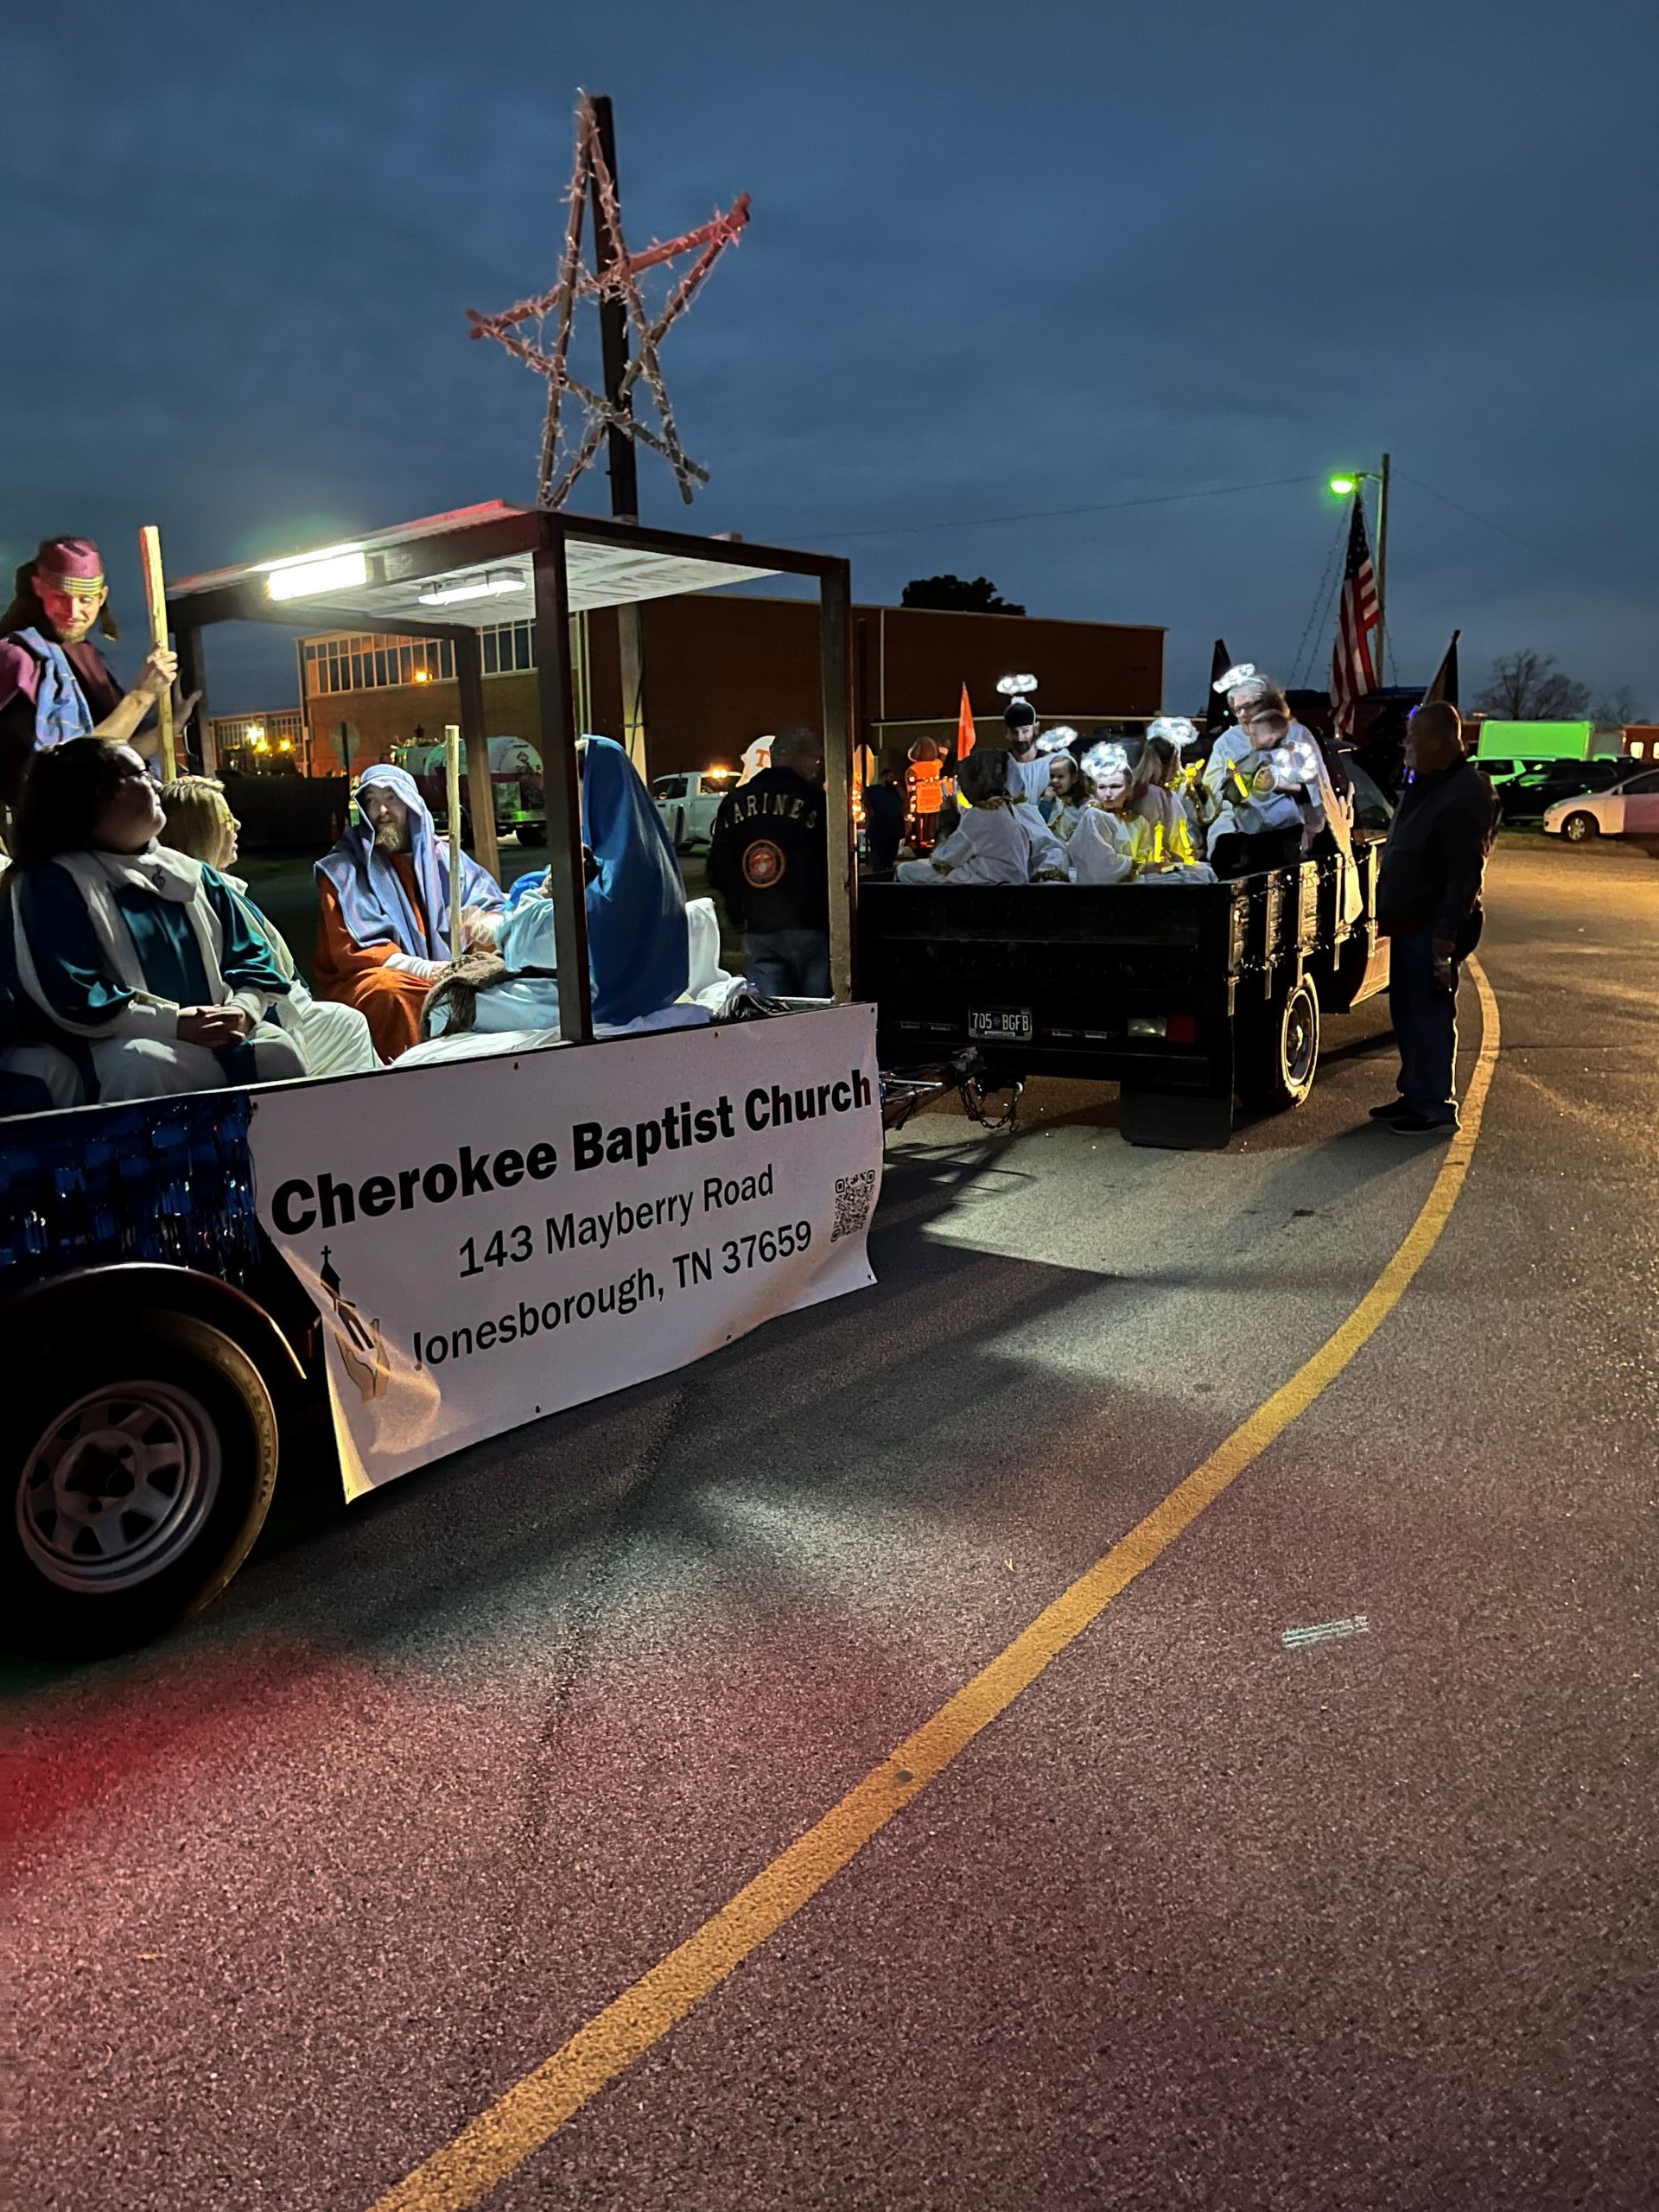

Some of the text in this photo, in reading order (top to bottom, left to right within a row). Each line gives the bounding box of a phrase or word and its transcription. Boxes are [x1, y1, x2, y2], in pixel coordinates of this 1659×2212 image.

[972, 1013, 1029, 1031] 705 BGFB
[271, 1069, 872, 1236] Cherokee Baptist Church
[460, 1164, 774, 1278] 143 Mayberry Road
[671, 1247, 713, 1288] TN
[721, 1220, 811, 1274] 37659
